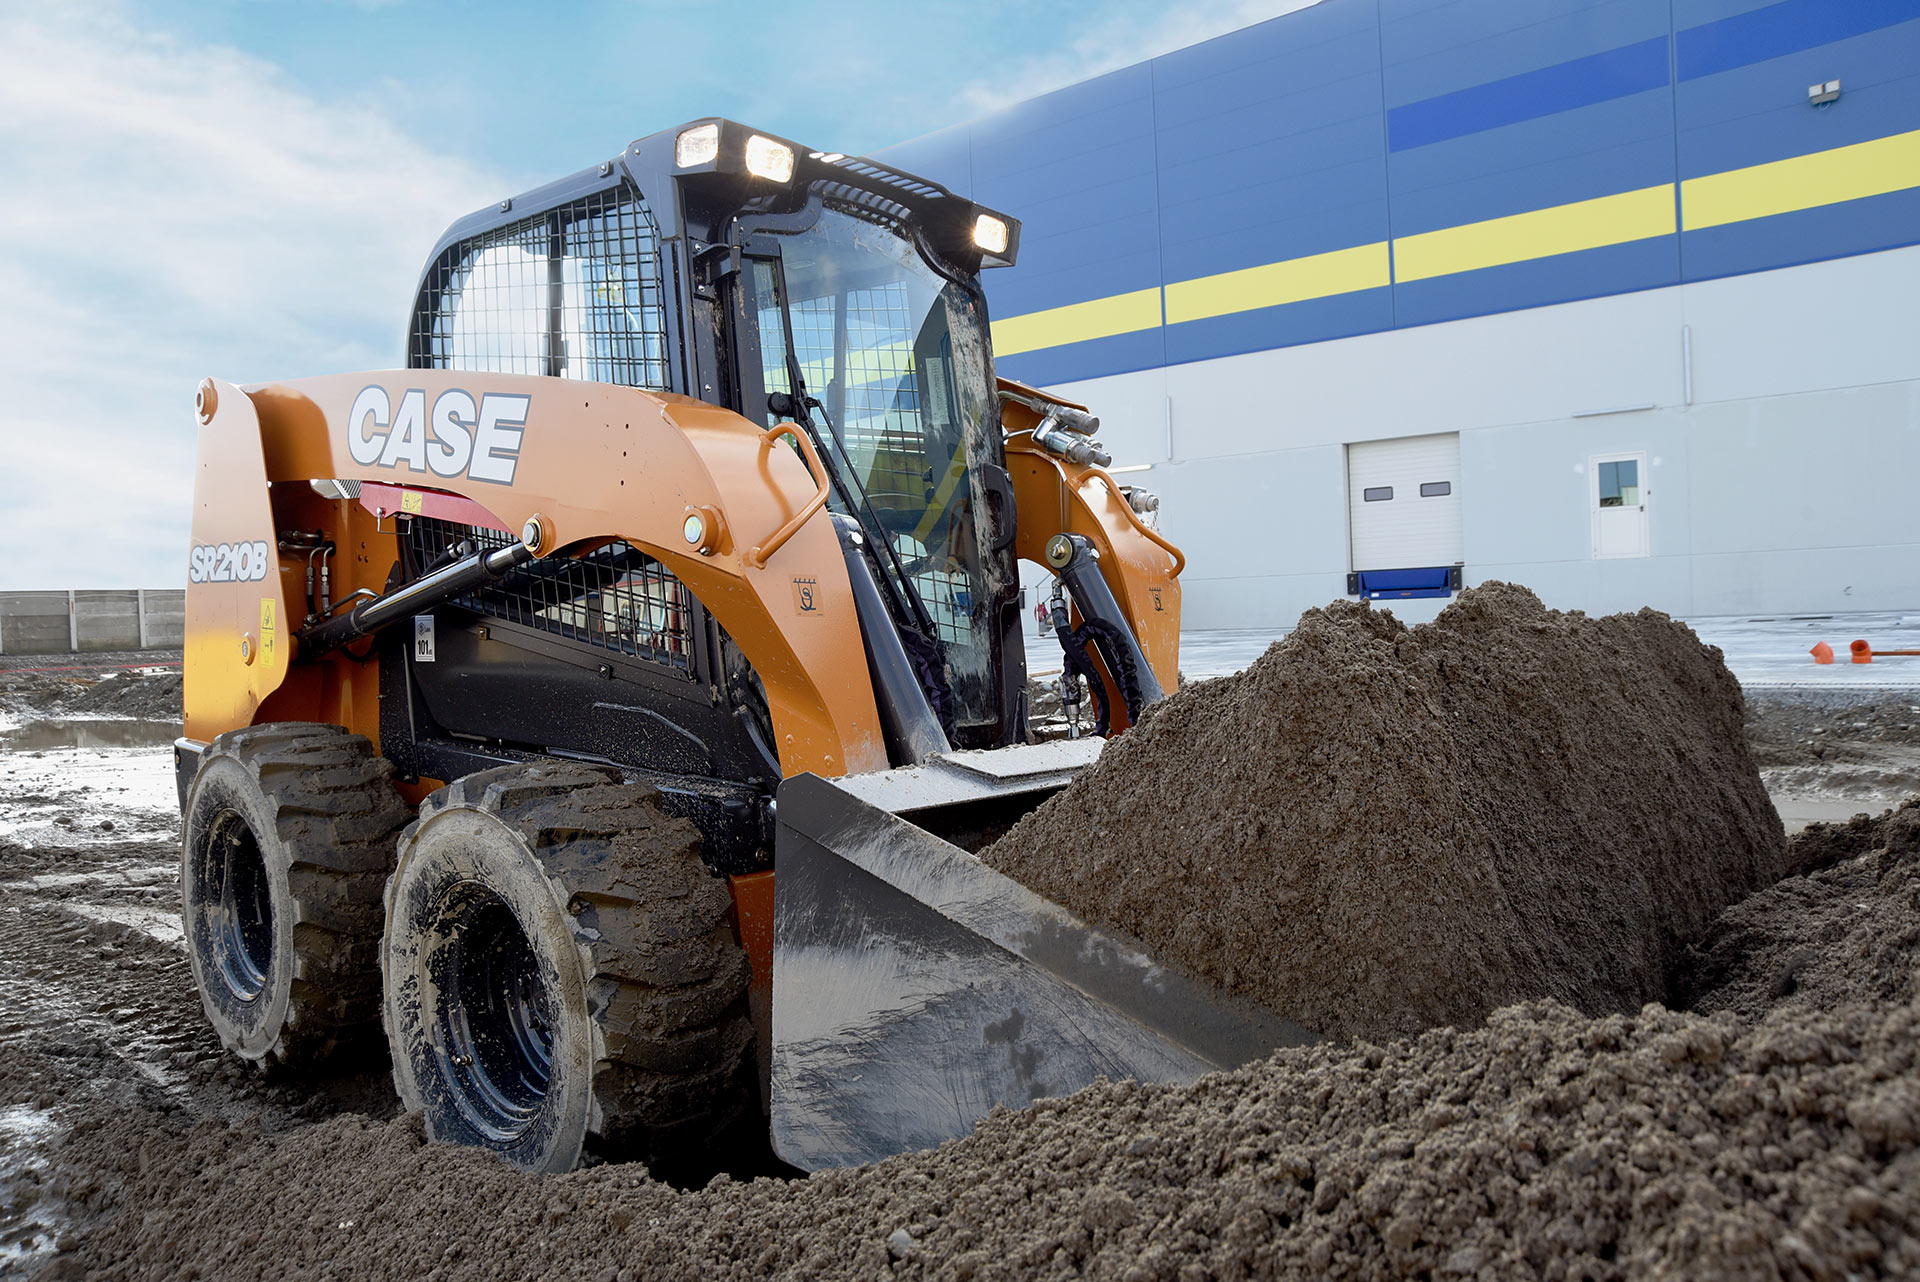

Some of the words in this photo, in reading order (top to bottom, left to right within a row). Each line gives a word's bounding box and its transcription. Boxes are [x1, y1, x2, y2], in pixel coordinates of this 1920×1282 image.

[348, 384, 532, 486] CASE
[190, 541, 268, 583] SR210B
[417, 639, 429, 655] 101
